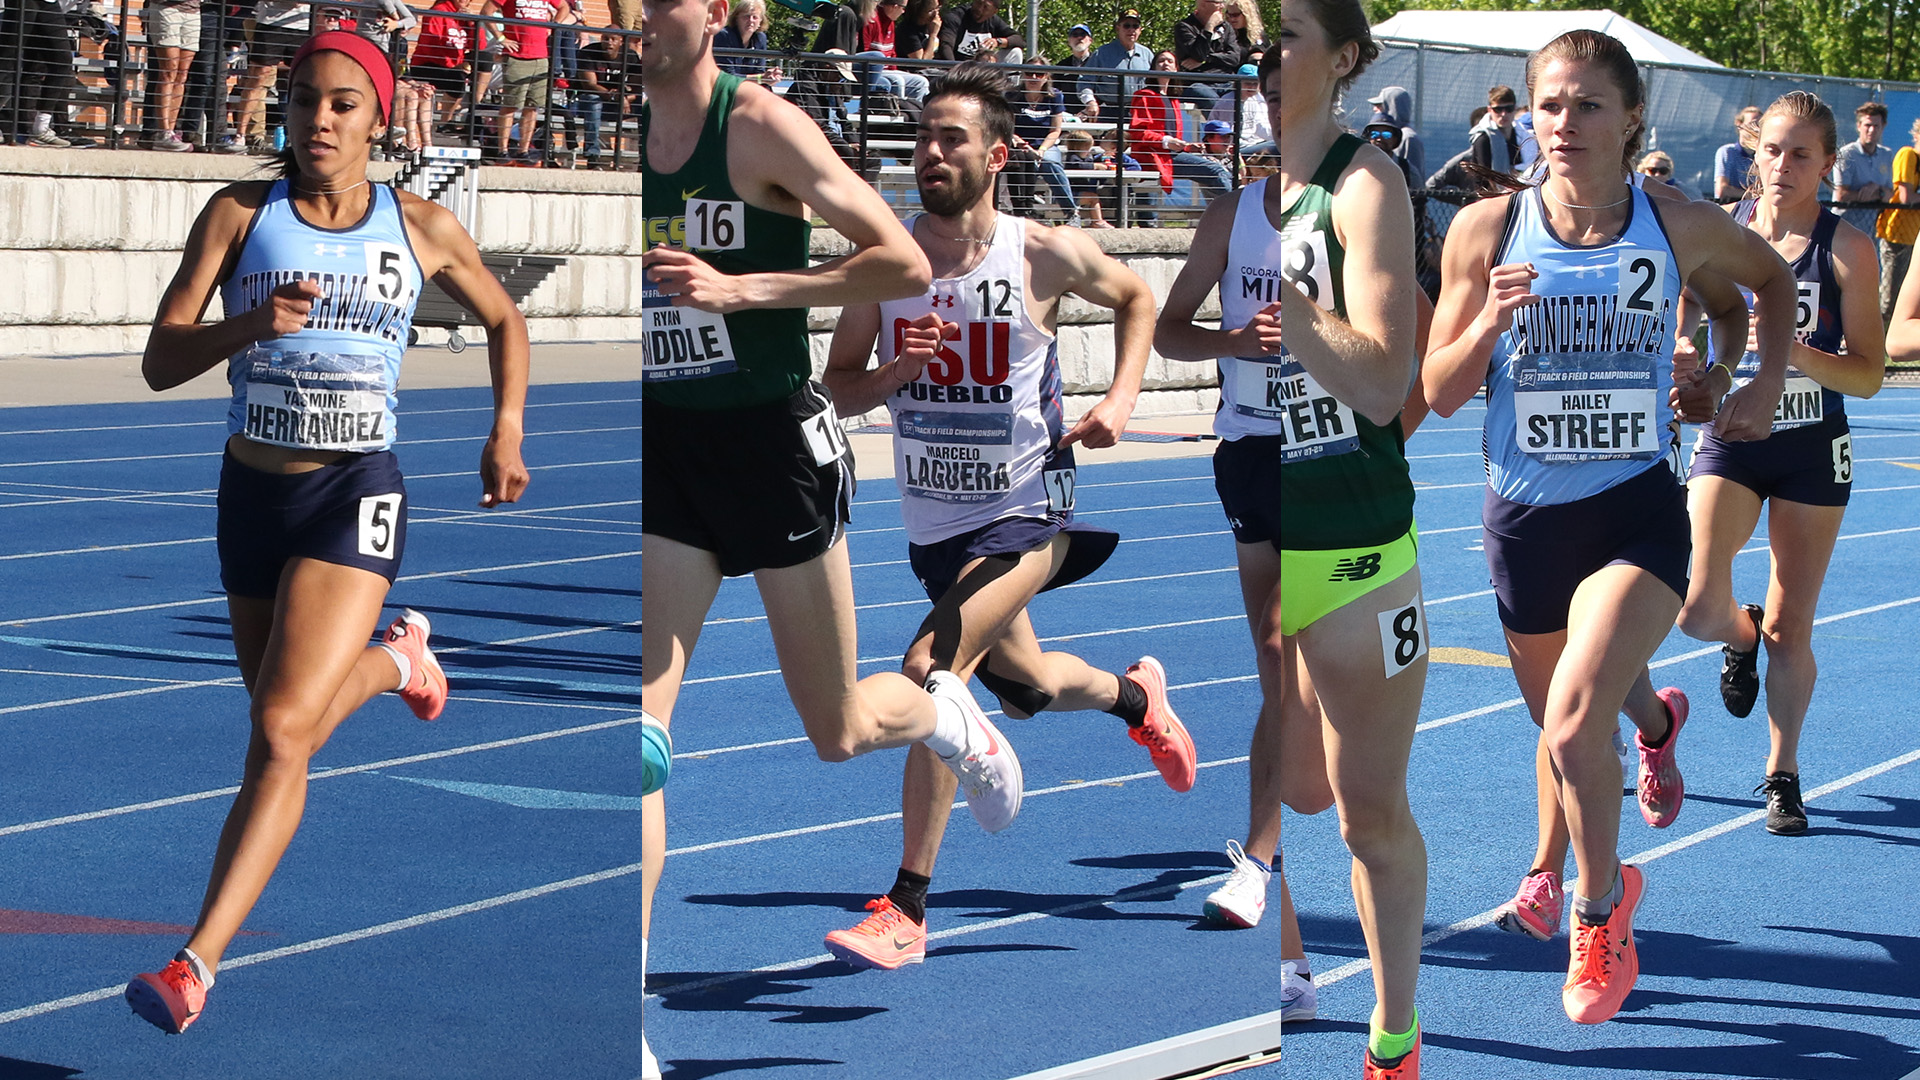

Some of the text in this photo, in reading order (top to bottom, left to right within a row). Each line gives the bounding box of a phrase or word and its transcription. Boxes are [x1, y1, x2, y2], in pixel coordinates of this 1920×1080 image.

[695, 203, 734, 247] 16
[378, 251, 402, 299] 5
[1283, 240, 1319, 303] 8
[1627, 258, 1656, 311] 2
[242, 270, 414, 341] THUERWOLVES
[976, 279, 1013, 317] 12
[653, 310, 681, 326] RYAN
[1508, 295, 1669, 355] HUNDERWOLVES
[642, 325, 723, 365] RIDDLE
[298, 371, 318, 380] FIELD
[896, 382, 1012, 404] PUEBLO
[1537, 371, 1651, 381] TRACK & FIELD CHAMPIONSHIPS
[284, 390, 346, 408] YASMINE
[1562, 394, 1612, 410] HAILEY
[248, 404, 384, 443] HERNANDEZ
[914, 426, 931, 434] TRACK
[954, 428, 1007, 437] CHAMPIONSHIPS
[1527, 412, 1646, 449] STREFF
[926, 445, 980, 461] MARCELO
[1287, 445, 1324, 459] MAY 27-29
[1840, 441, 1851, 480] 5
[905, 455, 1010, 491] LAGUERA
[1054, 471, 1074, 508] 12
[371, 501, 391, 552] 5
[1393, 606, 1419, 666] 8
